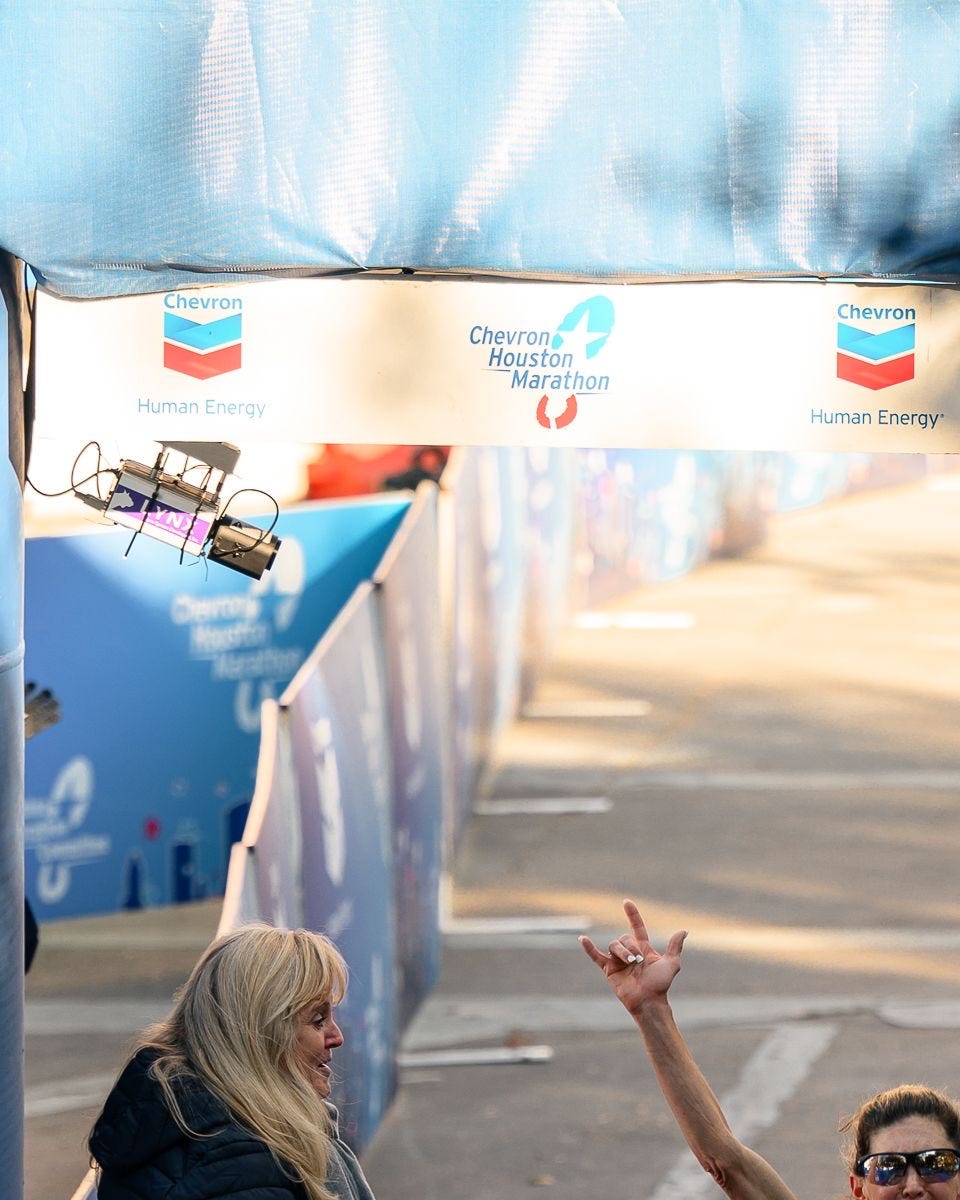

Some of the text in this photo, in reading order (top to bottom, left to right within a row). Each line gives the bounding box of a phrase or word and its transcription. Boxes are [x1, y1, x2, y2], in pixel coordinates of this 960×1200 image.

[163, 293, 243, 311] Chevron
[837, 303, 917, 321] Chevron
[470, 324, 551, 348] Chevron
[489, 346, 574, 369] Houston
[511, 368, 610, 391] Marathon
[137, 398, 266, 419] Human Energy
[810, 408, 872, 426] Human
